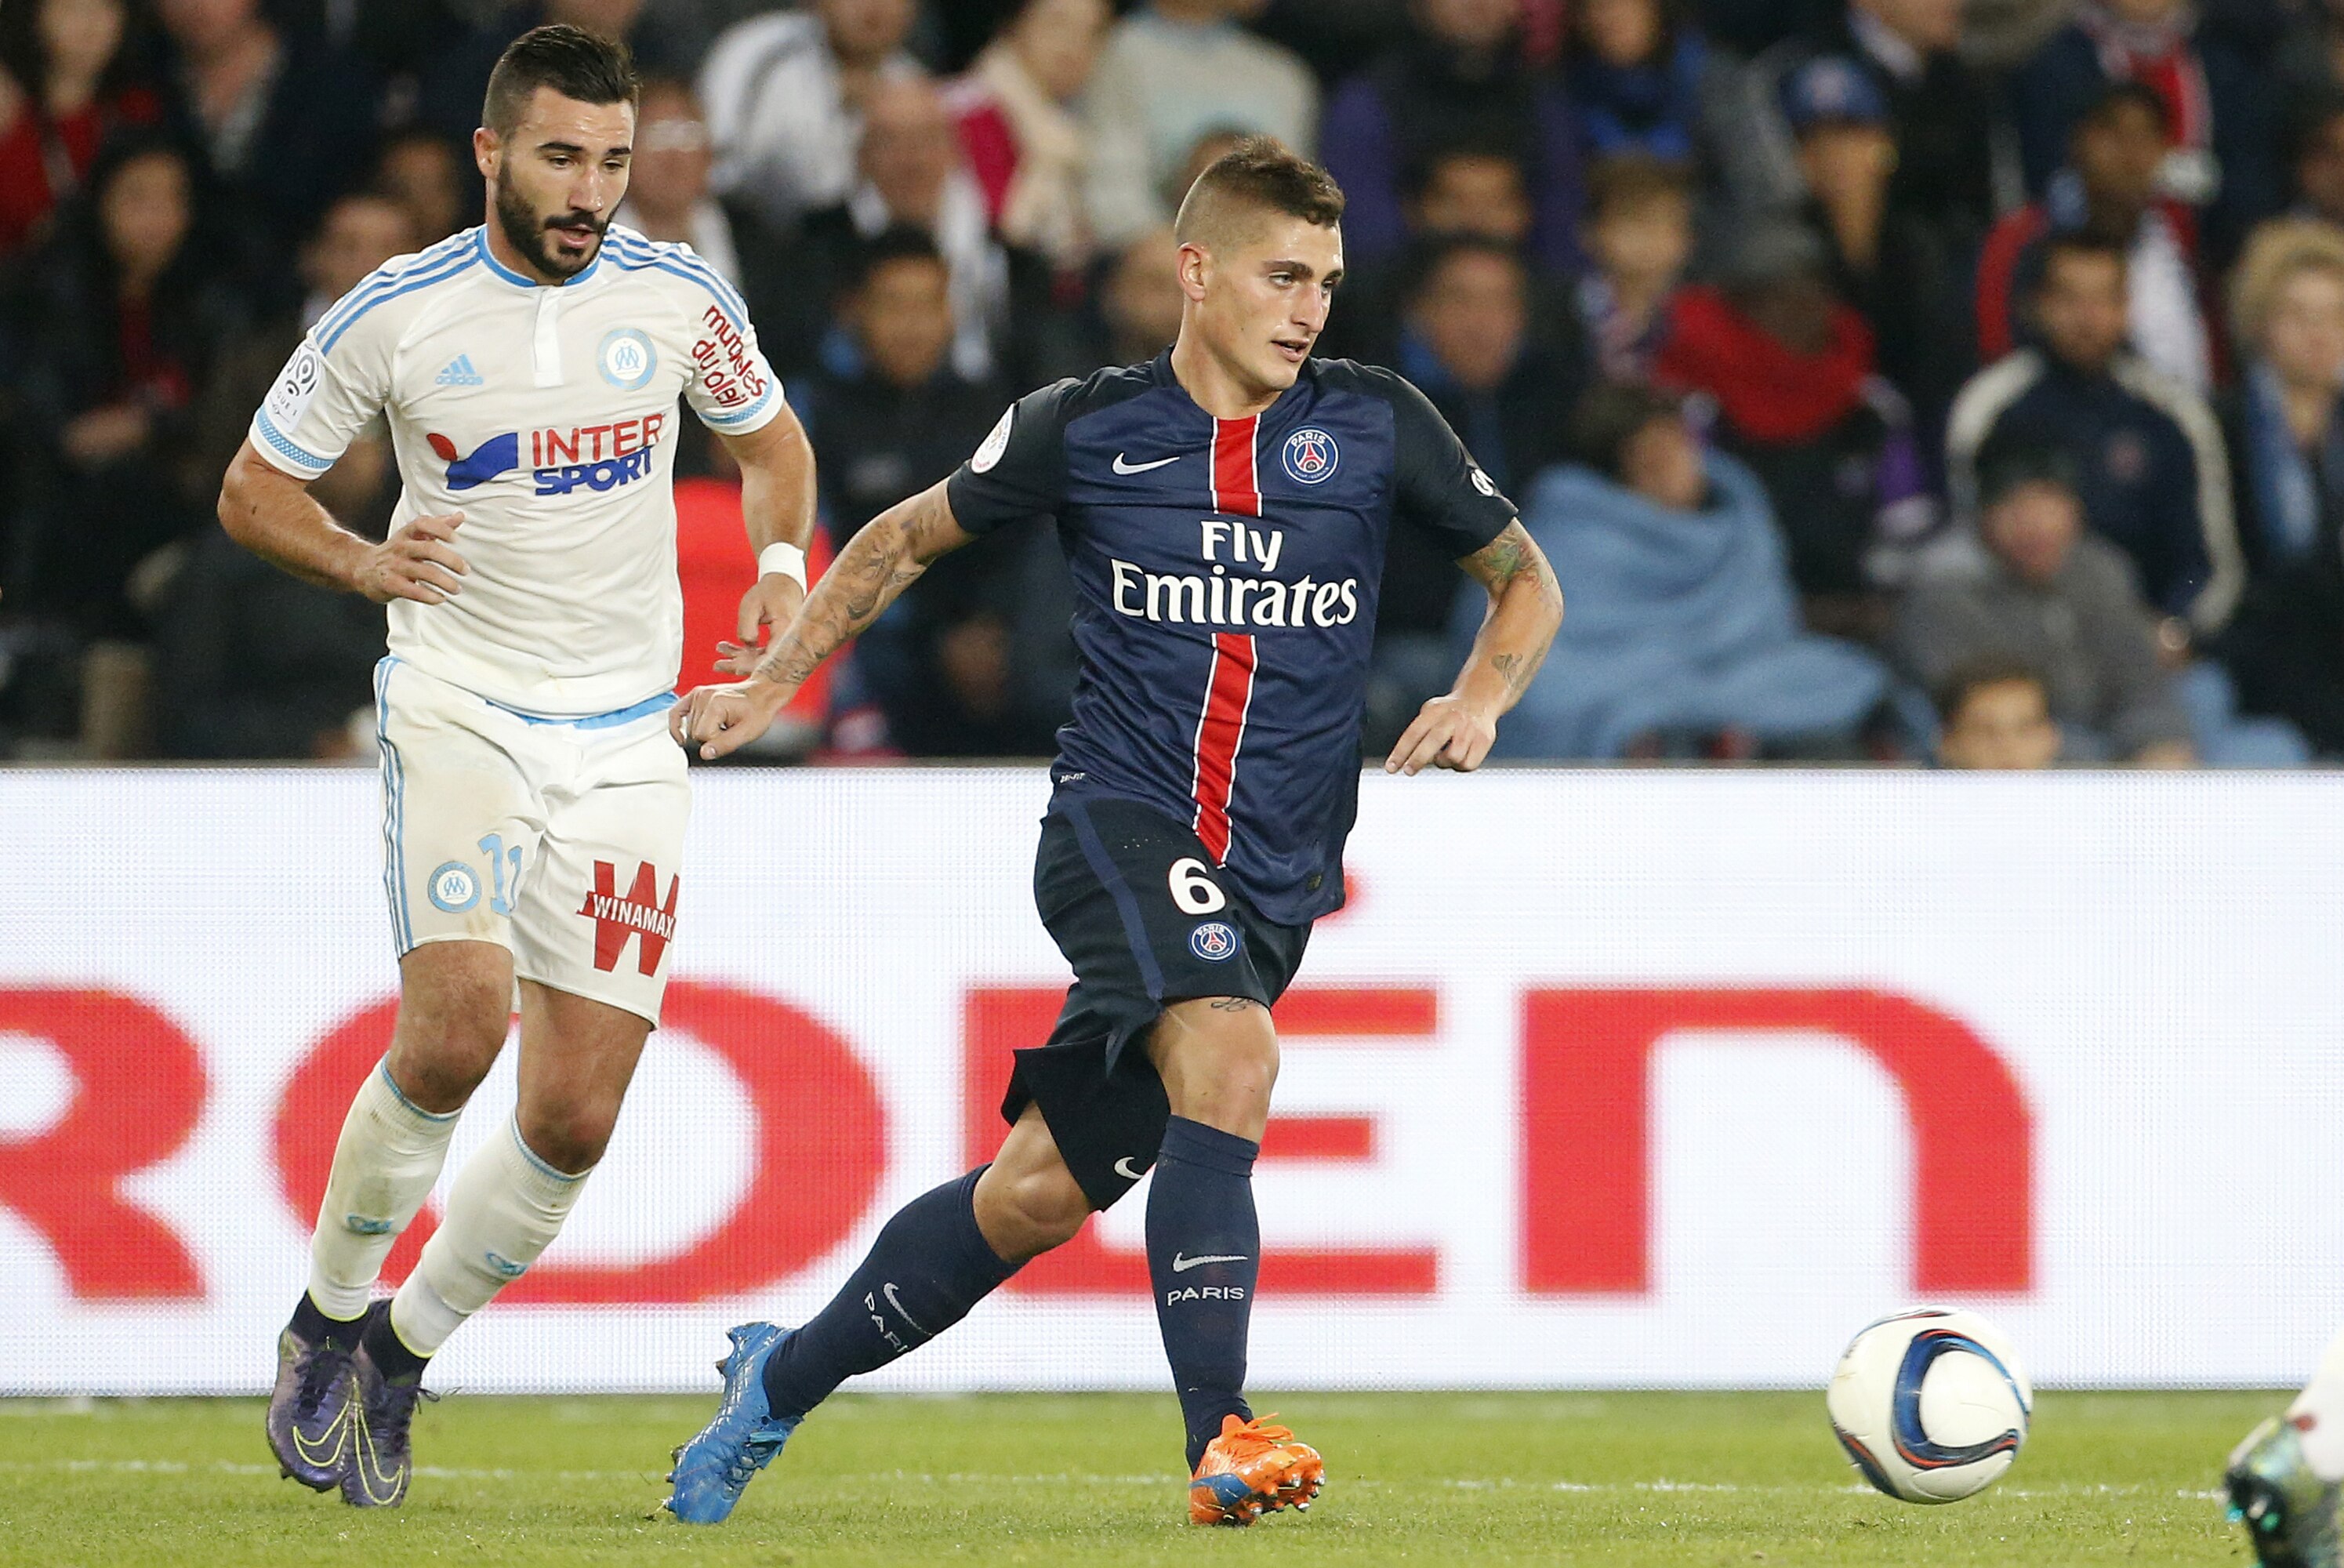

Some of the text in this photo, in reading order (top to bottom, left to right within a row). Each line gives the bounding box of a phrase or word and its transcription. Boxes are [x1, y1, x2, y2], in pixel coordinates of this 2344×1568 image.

[692, 339, 749, 408] du oleil
[702, 304, 767, 397] muteles
[532, 413, 663, 467] INTER
[1290, 432, 1326, 447] PARIS
[533, 445, 653, 495] SPORT
[1200, 521, 1283, 572] Fly
[1111, 558, 1358, 627] Emirates
[1168, 857, 1226, 915] 6
[593, 894, 676, 941] WINAMAX
[1167, 1285, 1245, 1307] PARIS
